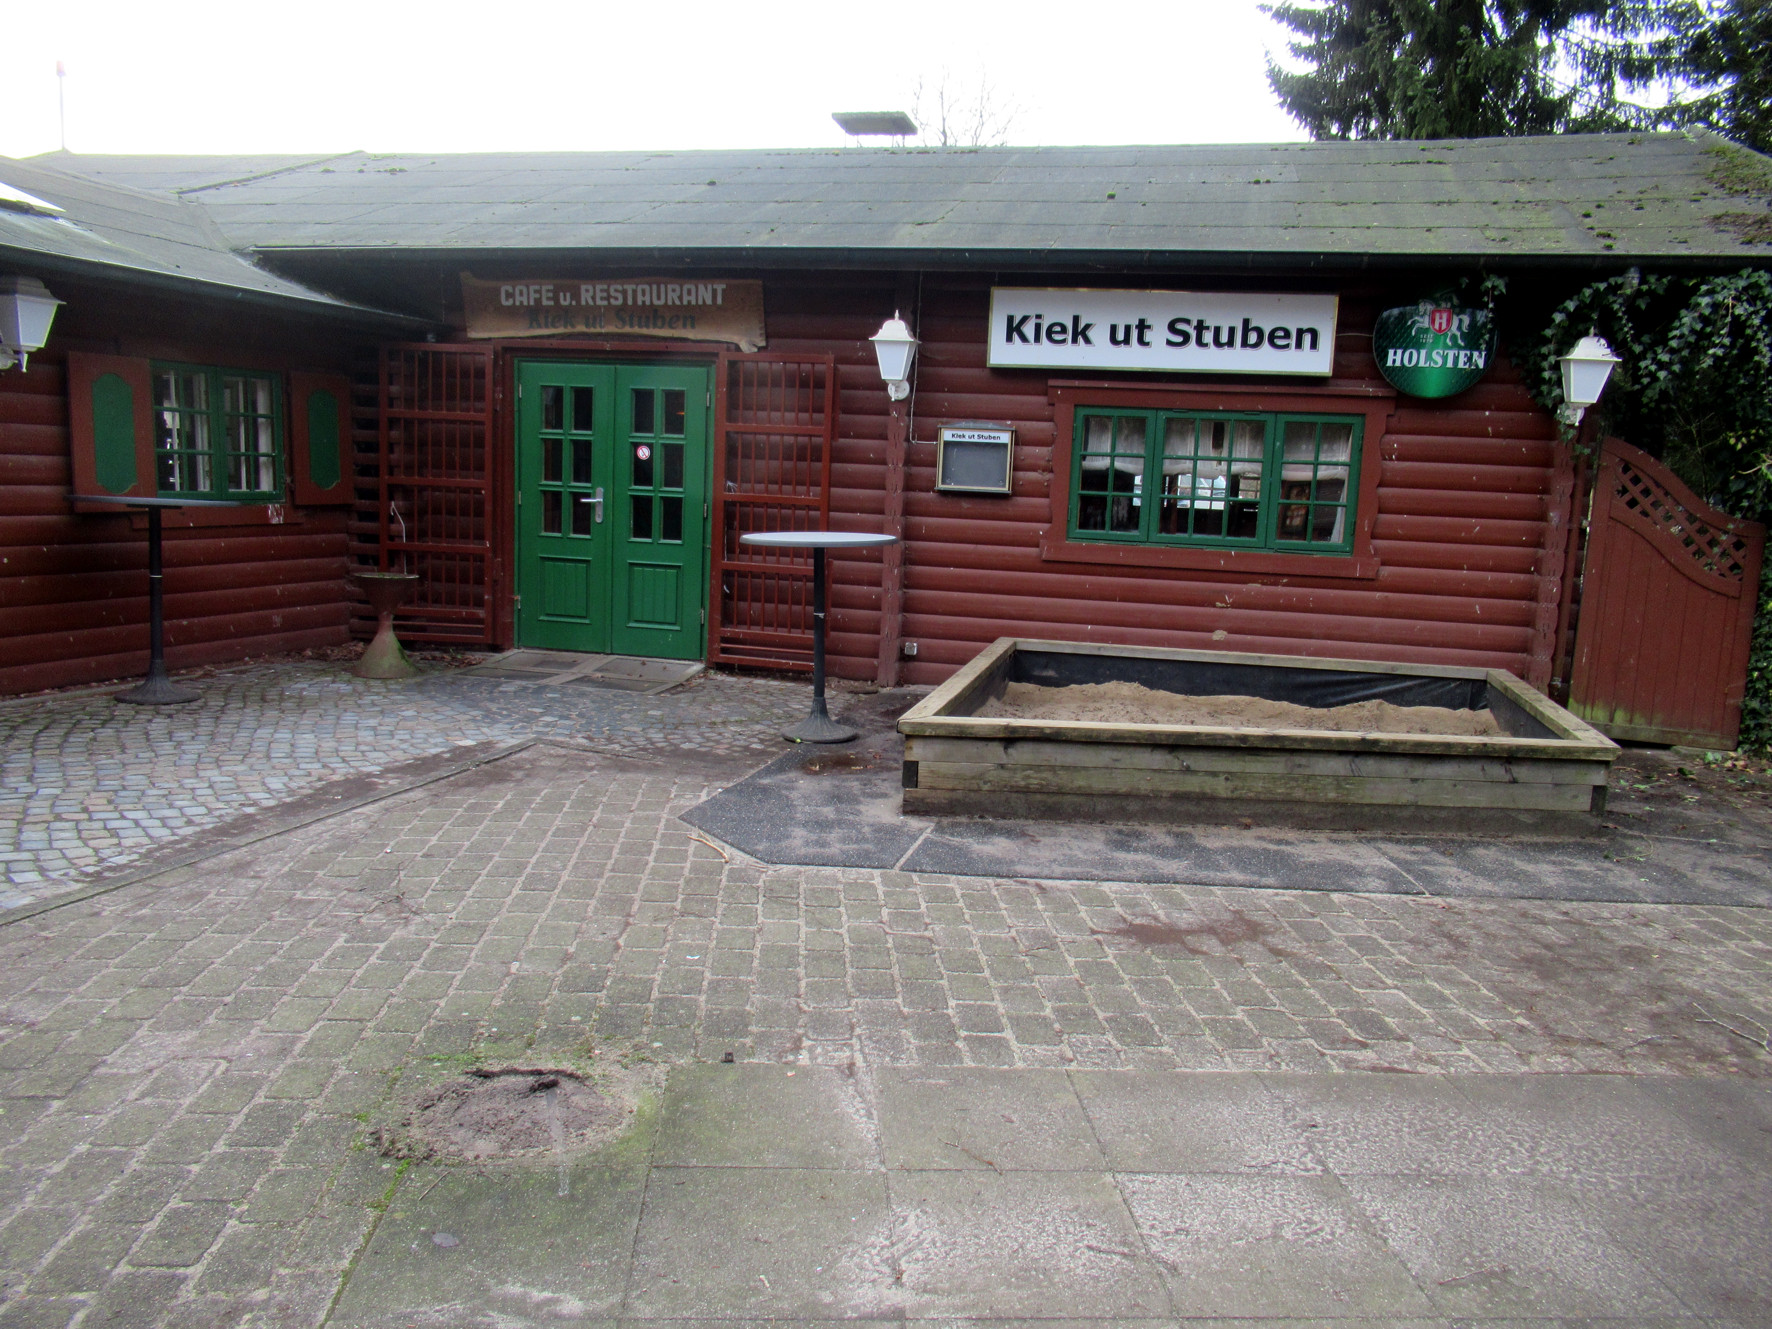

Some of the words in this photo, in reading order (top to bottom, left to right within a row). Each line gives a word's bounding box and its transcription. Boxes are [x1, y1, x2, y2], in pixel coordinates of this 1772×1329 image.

[500, 284, 554, 306] CAFE
[559, 291, 576, 306] u.
[580, 283, 727, 306] RESTAURANT
[614, 307, 697, 330] Stuben
[1004, 314, 1096, 347] Kiek
[1108, 317, 1153, 349] ut
[1165, 316, 1321, 352] Stuben
[1386, 348, 1486, 369] HOLSTEN
